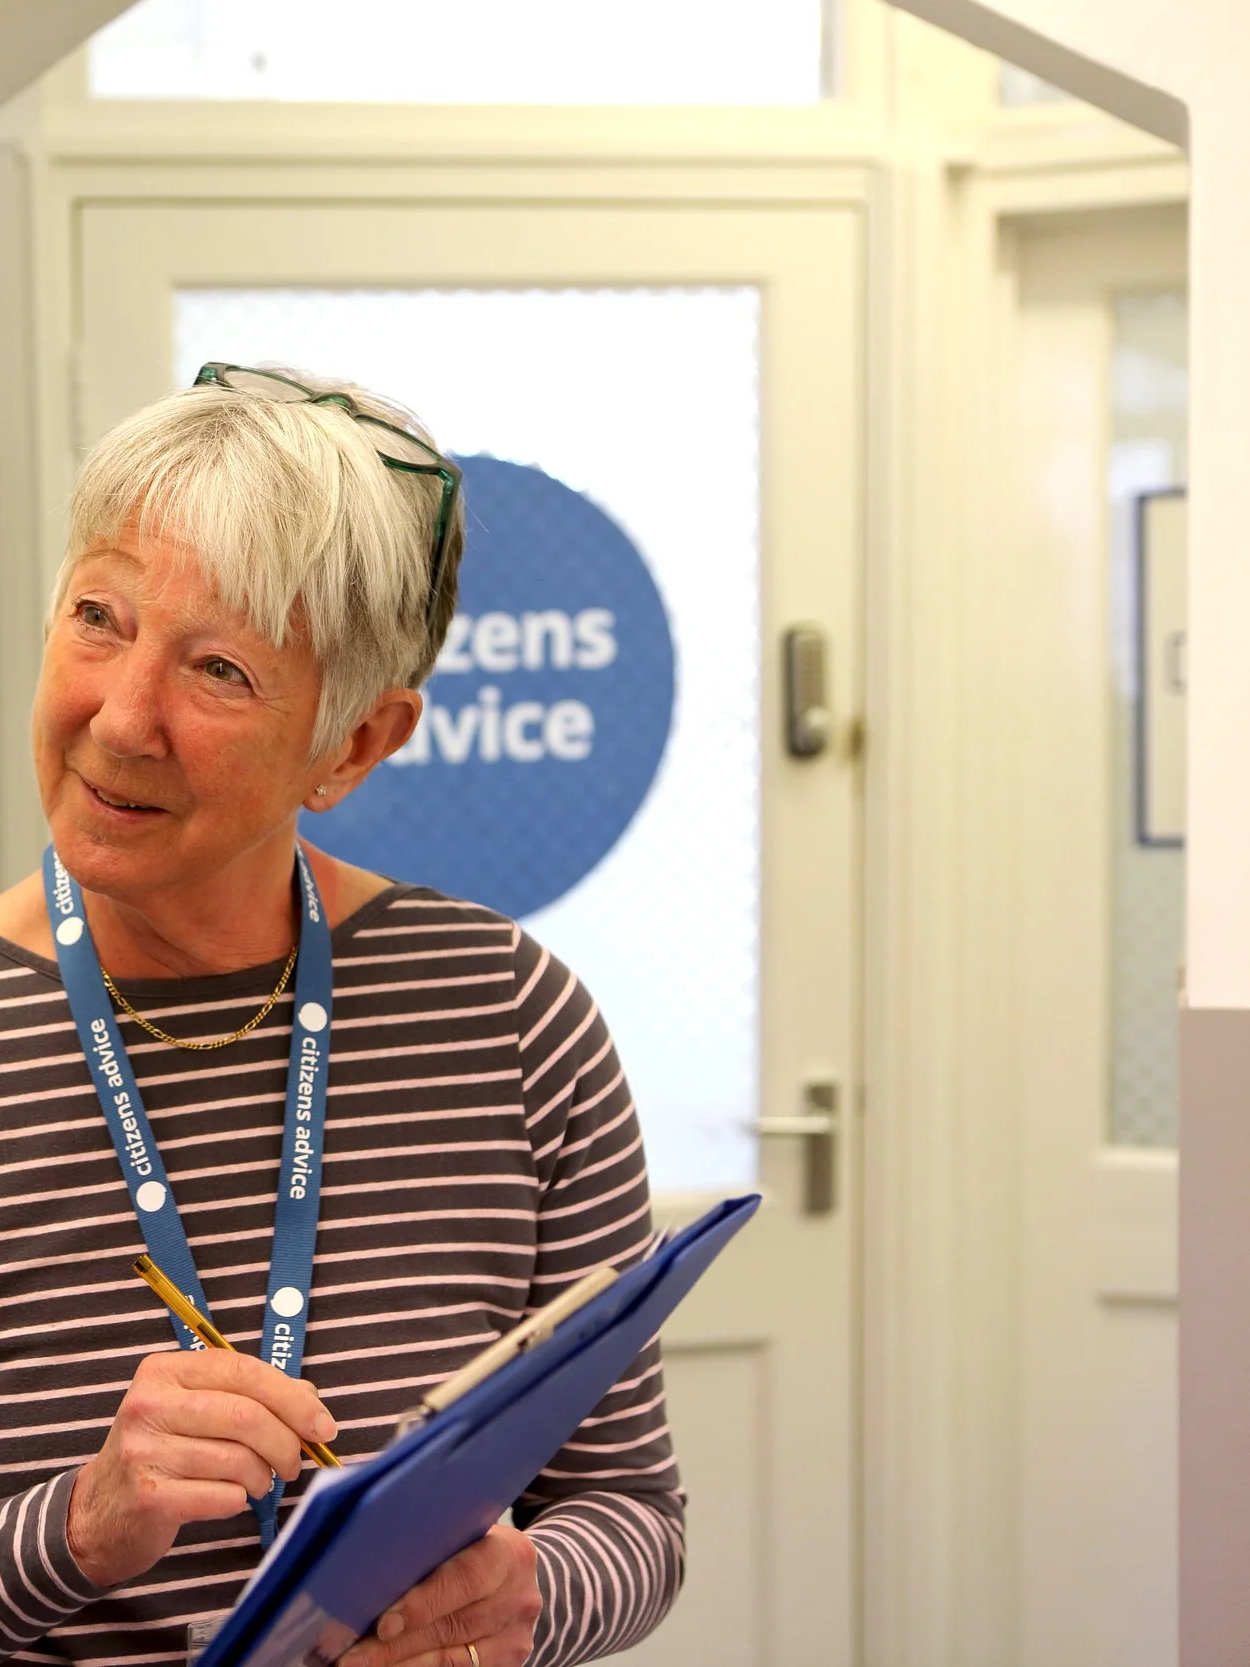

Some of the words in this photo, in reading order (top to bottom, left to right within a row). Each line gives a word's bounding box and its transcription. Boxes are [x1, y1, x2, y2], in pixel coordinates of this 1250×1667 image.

[90, 1018, 124, 1088] advice
[296, 1036, 321, 1122] citizens
[115, 1091, 152, 1176] citizens
[289, 1126, 315, 1200] advice
